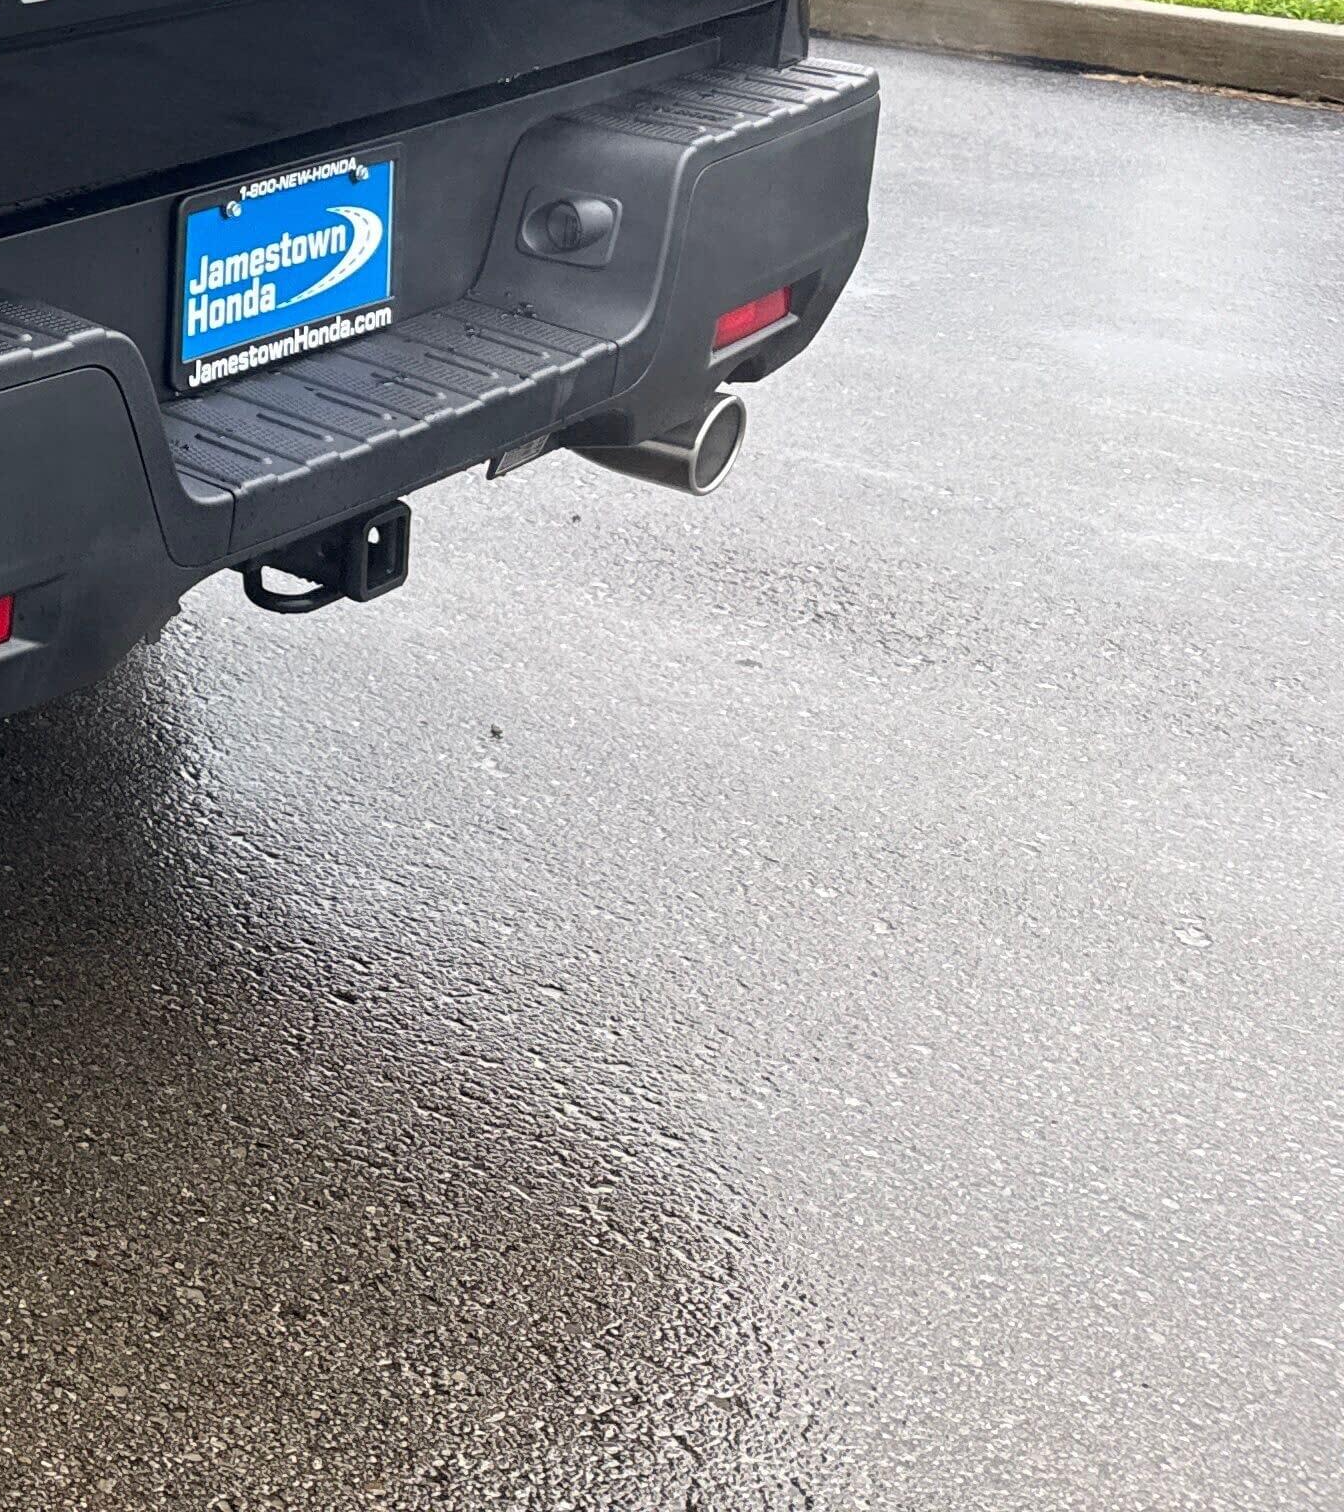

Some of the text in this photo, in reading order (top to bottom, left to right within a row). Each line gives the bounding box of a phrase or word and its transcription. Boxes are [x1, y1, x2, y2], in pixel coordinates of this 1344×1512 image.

[239, 157, 357, 201] 1-800-NEW-HONDA
[189, 224, 347, 296] Jamestown
[187, 277, 277, 337] Honda
[189, 306, 393, 388] JamestownHonda.com
